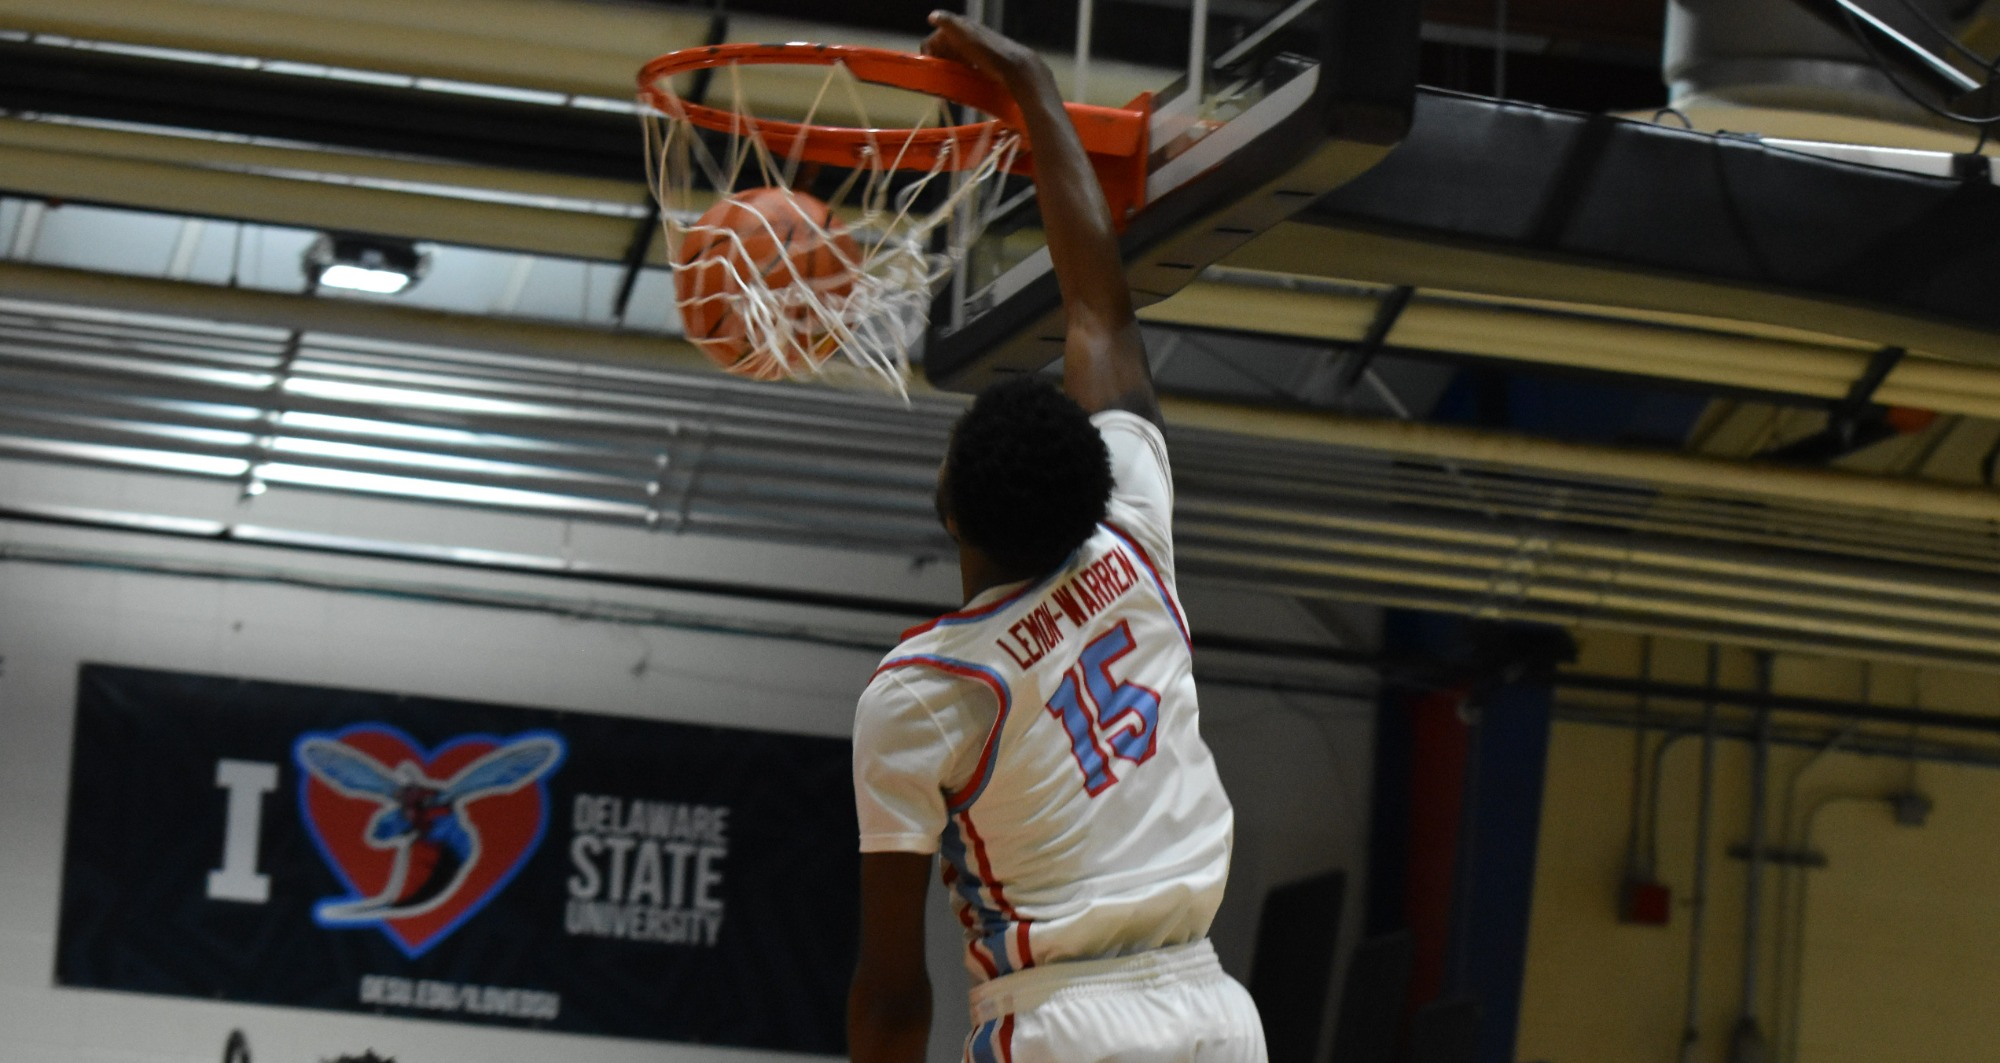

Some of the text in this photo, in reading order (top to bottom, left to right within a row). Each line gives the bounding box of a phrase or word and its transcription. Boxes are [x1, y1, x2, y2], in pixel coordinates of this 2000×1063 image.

[996, 545, 1139, 671] LEMON-WARREN
[1045, 618, 1162, 799] 15
[206, 757, 279, 904] I
[573, 793, 731, 844] DELAWARE
[567, 834, 727, 909] STATE
[565, 899, 723, 947] UNIVERSITY
